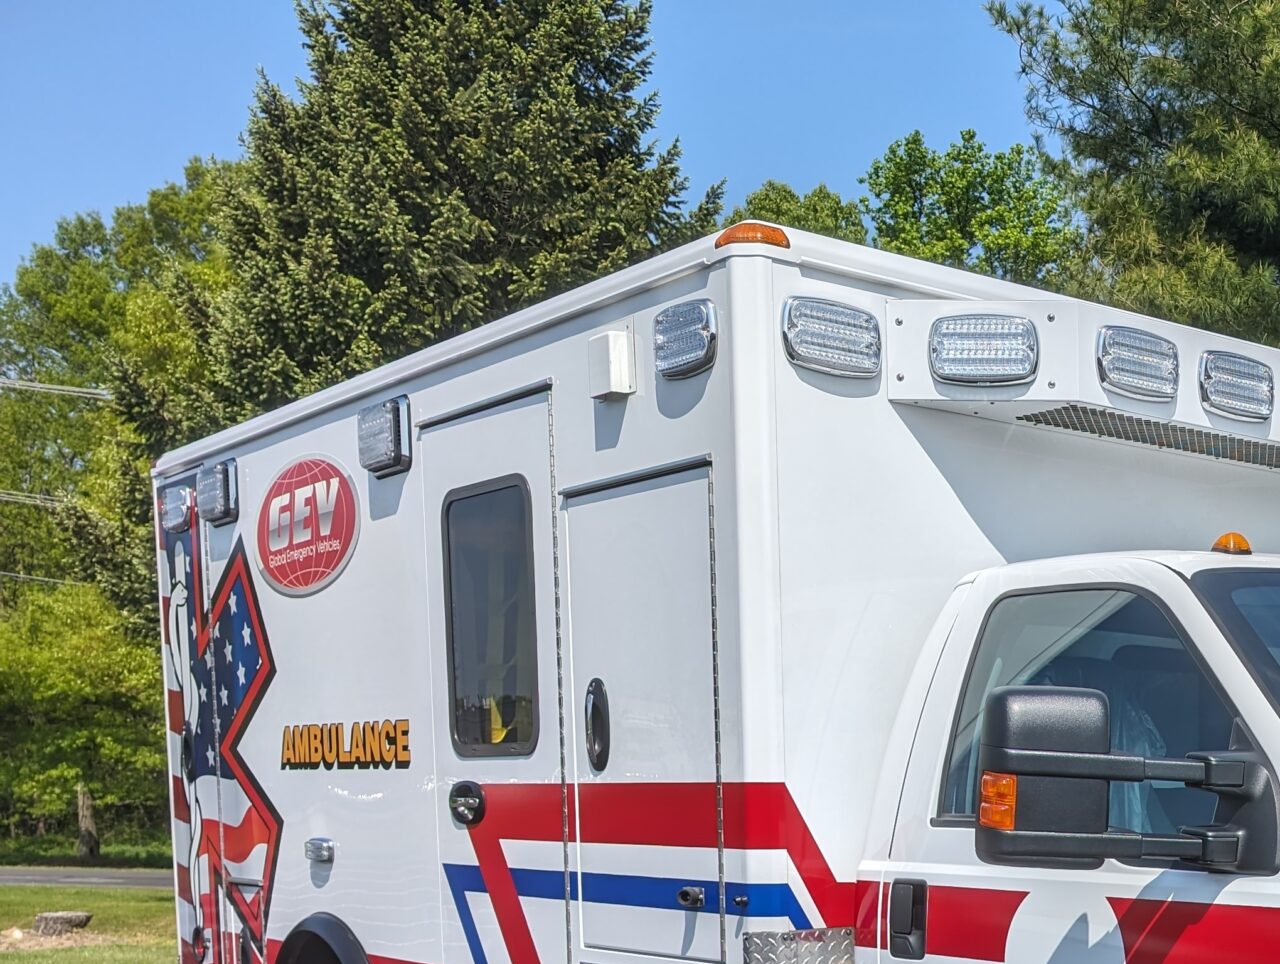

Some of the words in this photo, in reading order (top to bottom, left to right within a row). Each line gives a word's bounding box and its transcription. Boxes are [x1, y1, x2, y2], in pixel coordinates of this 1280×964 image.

[269, 477, 340, 552] GEV
[269, 553, 288, 568] Global
[286, 544, 317, 562] Emergency
[316, 538, 341, 553] Vehicles
[280, 718, 411, 771] AMBULANCE
